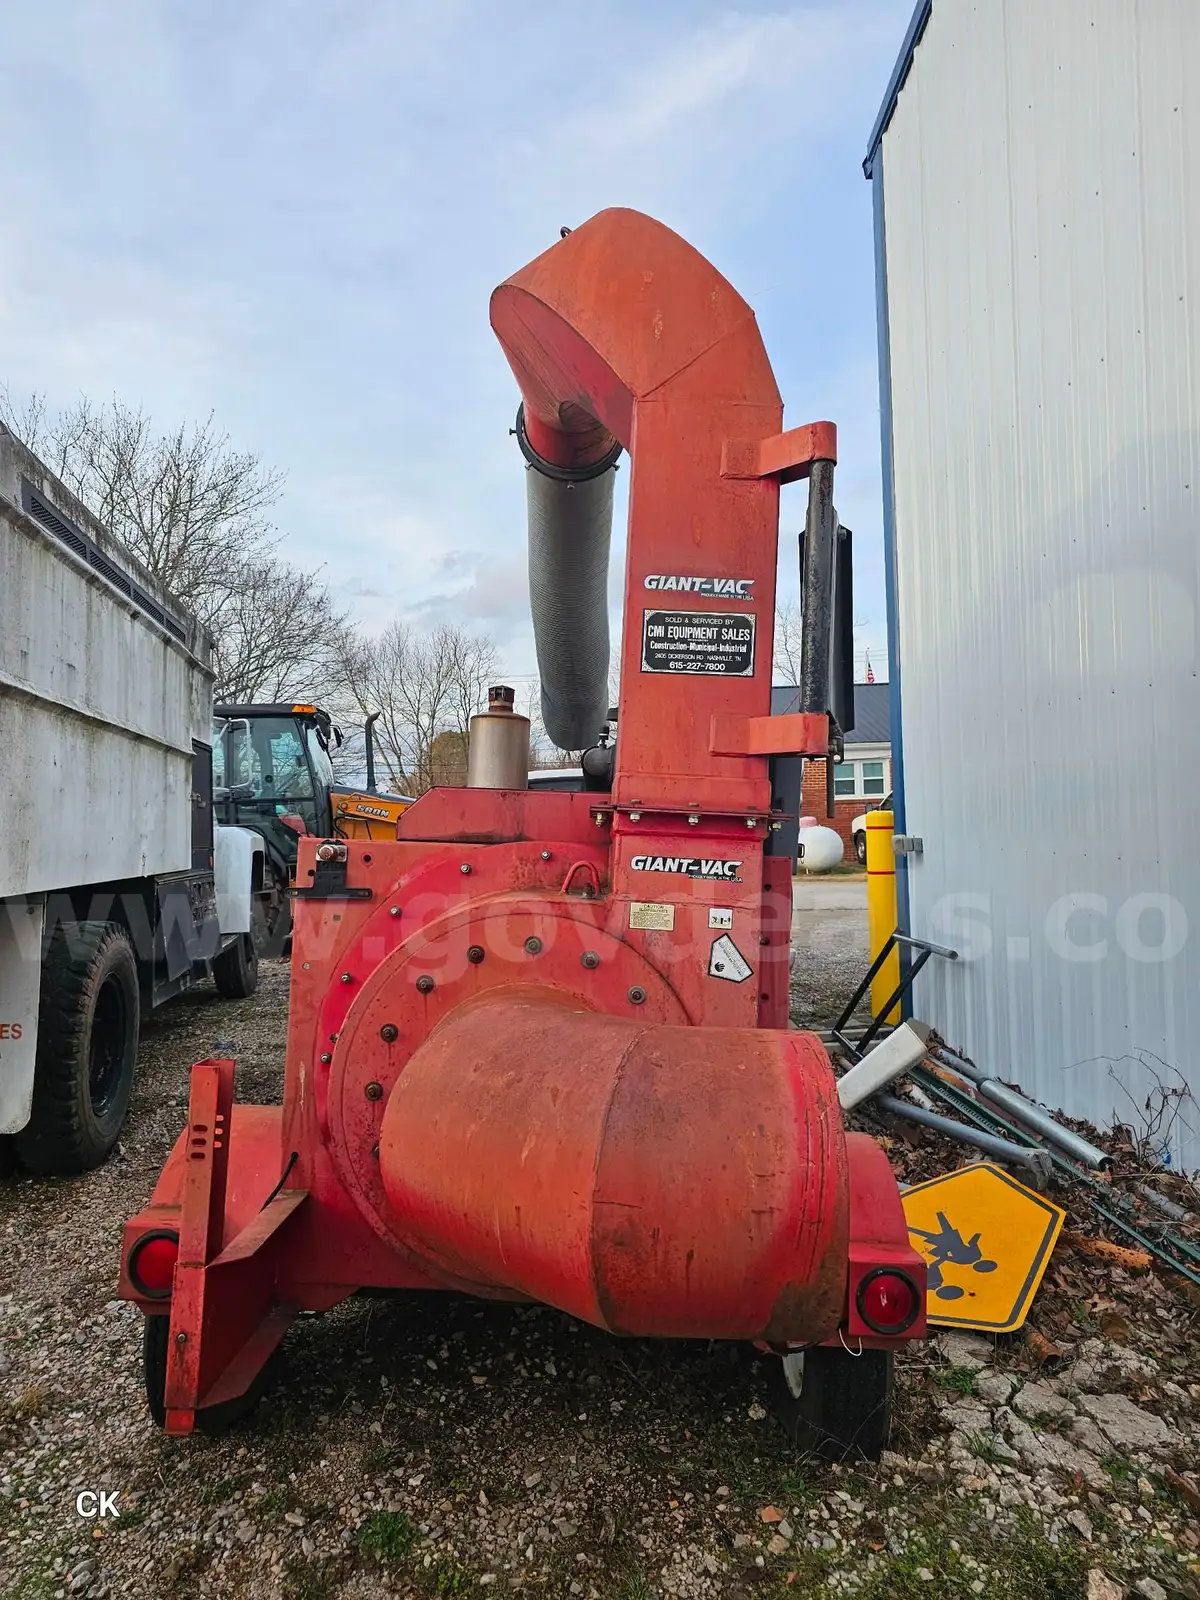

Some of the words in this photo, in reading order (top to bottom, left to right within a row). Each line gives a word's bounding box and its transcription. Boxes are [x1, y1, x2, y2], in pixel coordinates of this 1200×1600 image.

[644, 575, 755, 594] GIANT-VAC
[648, 625, 665, 637] CMI
[668, 626, 718, 640] EQUIPMENT
[721, 628, 750, 641] SALES
[669, 662, 725, 671] 615-227-7800
[631, 856, 742, 875] GIANT-VAC
